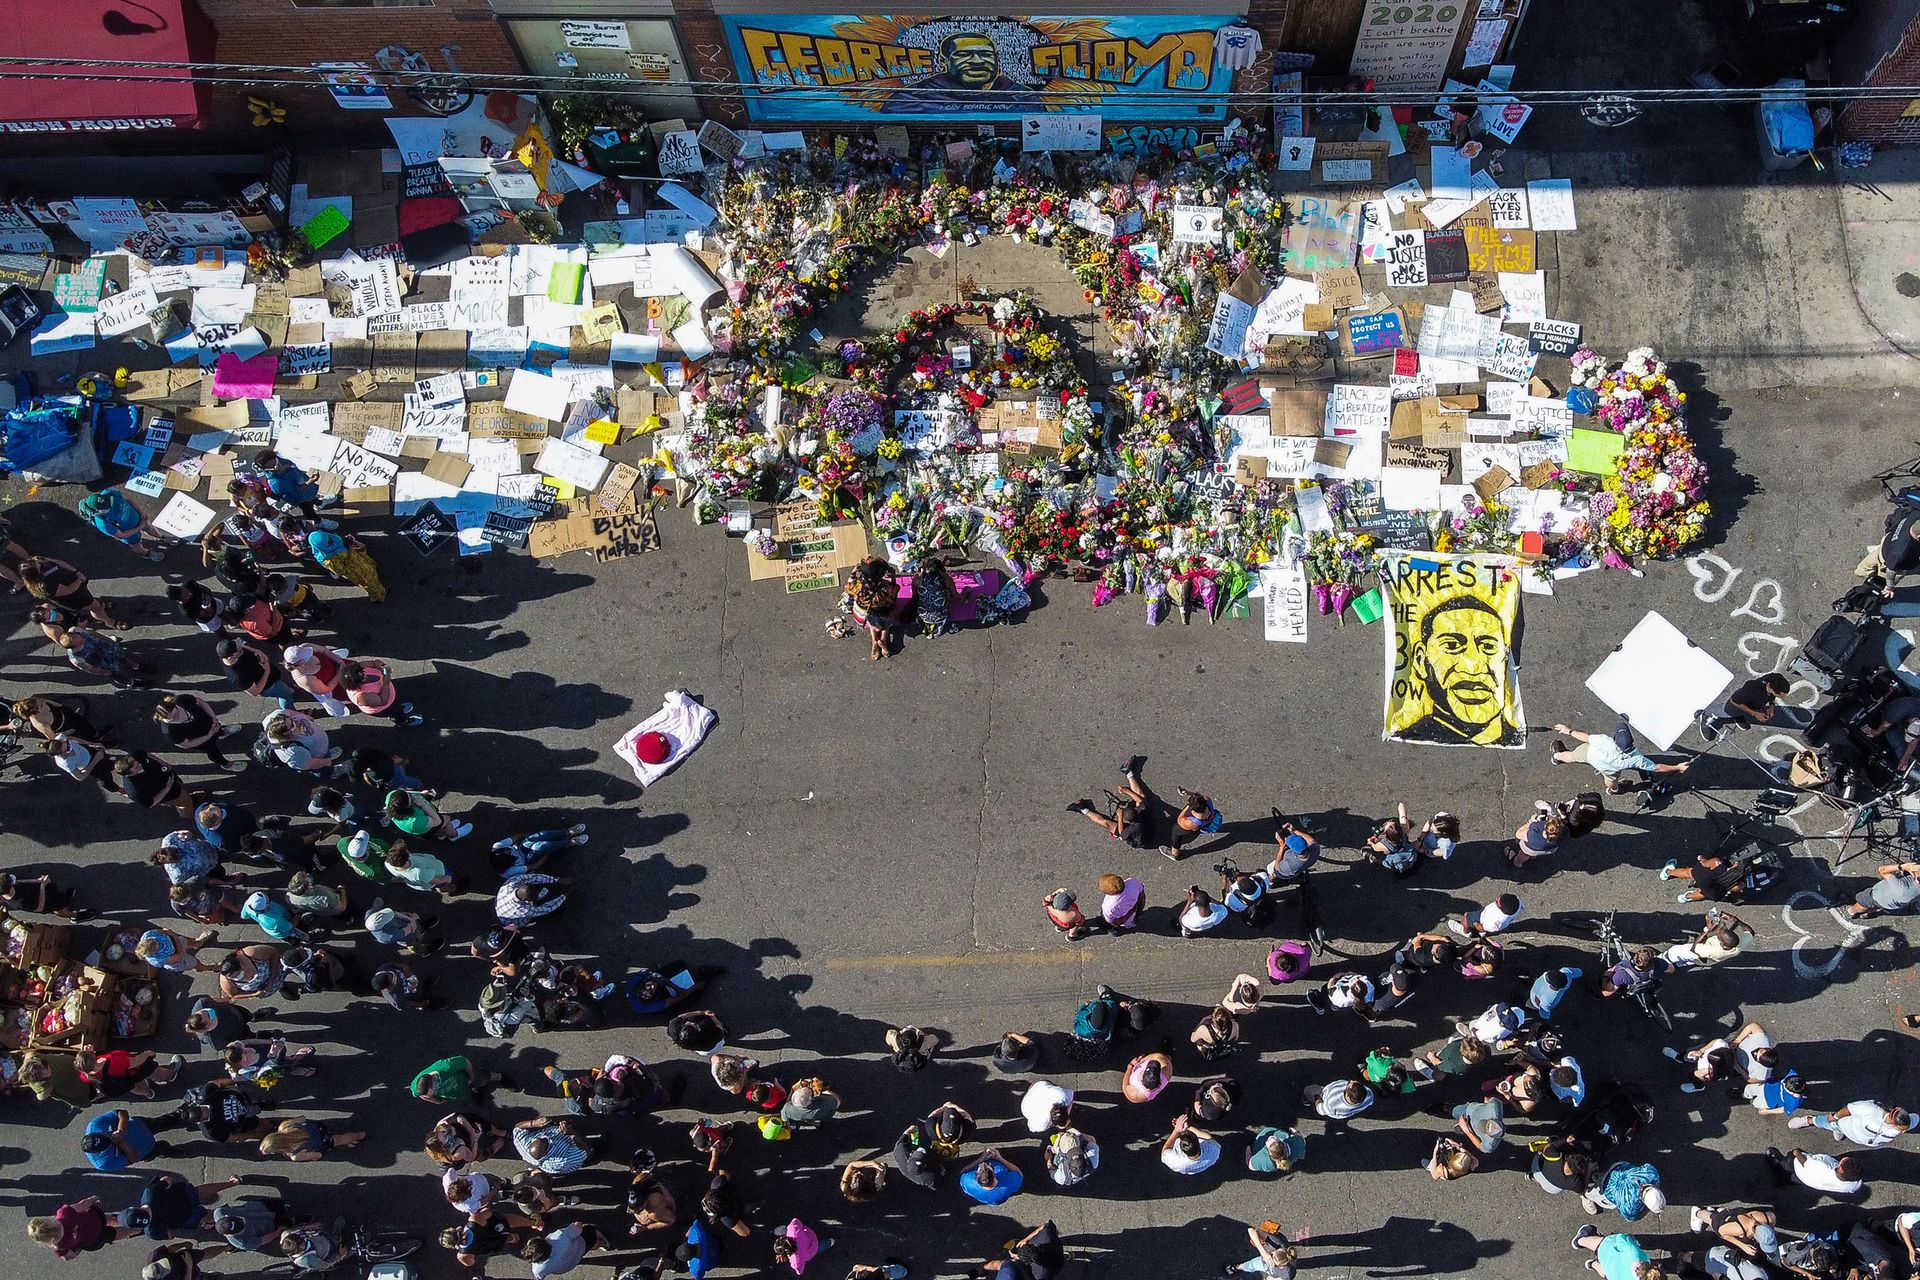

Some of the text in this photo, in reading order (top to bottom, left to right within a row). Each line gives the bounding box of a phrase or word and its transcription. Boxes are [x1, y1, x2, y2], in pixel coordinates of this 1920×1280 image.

[1370, 5, 1457, 25] 2020
[1377, 27, 1405, 36] can't
[1410, 26, 1453, 34] breathe
[1360, 41, 1389, 50] People
[1420, 40, 1447, 49] angry
[741, 27, 934, 87] GEORGE
[1032, 31, 1215, 90] FLOYD
[1356, 52, 1434, 63] because waiting
[1387, 74, 1408, 82] NOT
[0, 118, 175, 132] FRESH PRODUCE
[1492, 118, 1515, 137] LOVE
[666, 134, 687, 151] We
[660, 145, 698, 163] CANNOT
[407, 174, 437, 187] BREATHE
[406, 186, 433, 197] GONNA
[1494, 193, 1517, 202] ACK
[1492, 202, 1521, 211] IVES
[1493, 211, 1522, 220] TTER
[1395, 234, 1415, 248] NO
[1466, 226, 1500, 243] THE
[1388, 245, 1426, 264] JUSTICE
[1481, 244, 1531, 259] TIME
[1469, 253, 1531, 273] IS NOW
[1399, 264, 1416, 276] NO
[1319, 277, 1356, 290] JUSTICE
[1391, 270, 1427, 285] PEACE
[361, 274, 378, 311] WHOLE
[411, 303, 444, 313] BLACK
[386, 315, 401, 323] LIFE
[412, 312, 445, 321] LIVES
[1350, 319, 1365, 327] WHO
[371, 323, 404, 332] MATTERS
[411, 320, 448, 330] MATTER
[1351, 323, 1381, 333] PROTECT
[1533, 321, 1576, 336] BLACKS
[197, 324, 238, 348] JEWS
[1532, 332, 1575, 345] ARE HUMANS
[287, 345, 327, 362] JUSTICE
[1539, 341, 1568, 353] TOO!
[300, 361, 329, 374] PEACE
[382, 367, 411, 375] STAND
[1493, 359, 1527, 379] Power
[419, 381, 431, 392] NO
[422, 390, 435, 401] NO
[1337, 387, 1368, 400] BLACK
[283, 404, 328, 420] PROSECUTE
[581, 402, 600, 418] NO
[1516, 401, 1573, 420] JUSTICE
[152, 418, 174, 428] JUSTICE
[473, 416, 516, 431] GEORGE
[518, 421, 546, 432] FLOYD
[1334, 414, 1388, 427] MATTERS!
[1439, 421, 1451, 432] 4
[152, 429, 167, 439] FOR
[239, 430, 270, 443] KROLL
[1273, 438, 1317, 448] HE WAS
[1389, 443, 1411, 452] WHO
[1521, 442, 1563, 452] PROSECUTE
[1409, 451, 1428, 459] THE
[335, 446, 394, 480] NO Justice
[149, 472, 165, 484] LIVES
[618, 465, 637, 478] STAND
[135, 478, 157, 490] MATTER
[500, 481, 521, 494] SAY
[1185, 471, 1231, 491] BLACK
[536, 483, 558, 495] BLACK
[1191, 487, 1222, 498] LIVES
[532, 491, 556, 504] LIVES
[528, 501, 552, 512] MATTER
[426, 513, 442, 528] SAY
[593, 505, 650, 535] BLACK
[1387, 512, 1412, 521] BLACK
[418, 518, 436, 536] THEIR
[537, 522, 557, 534] Say
[411, 524, 434, 548] NAMES
[811, 532, 831, 541] Your
[793, 541, 834, 552] MASKS
[789, 578, 834, 592] COVID 19
[1382, 560, 1505, 597] ARREST
[1287, 587, 1305, 636] HEALED
[224, 1099, 232, 1120] LOVE
